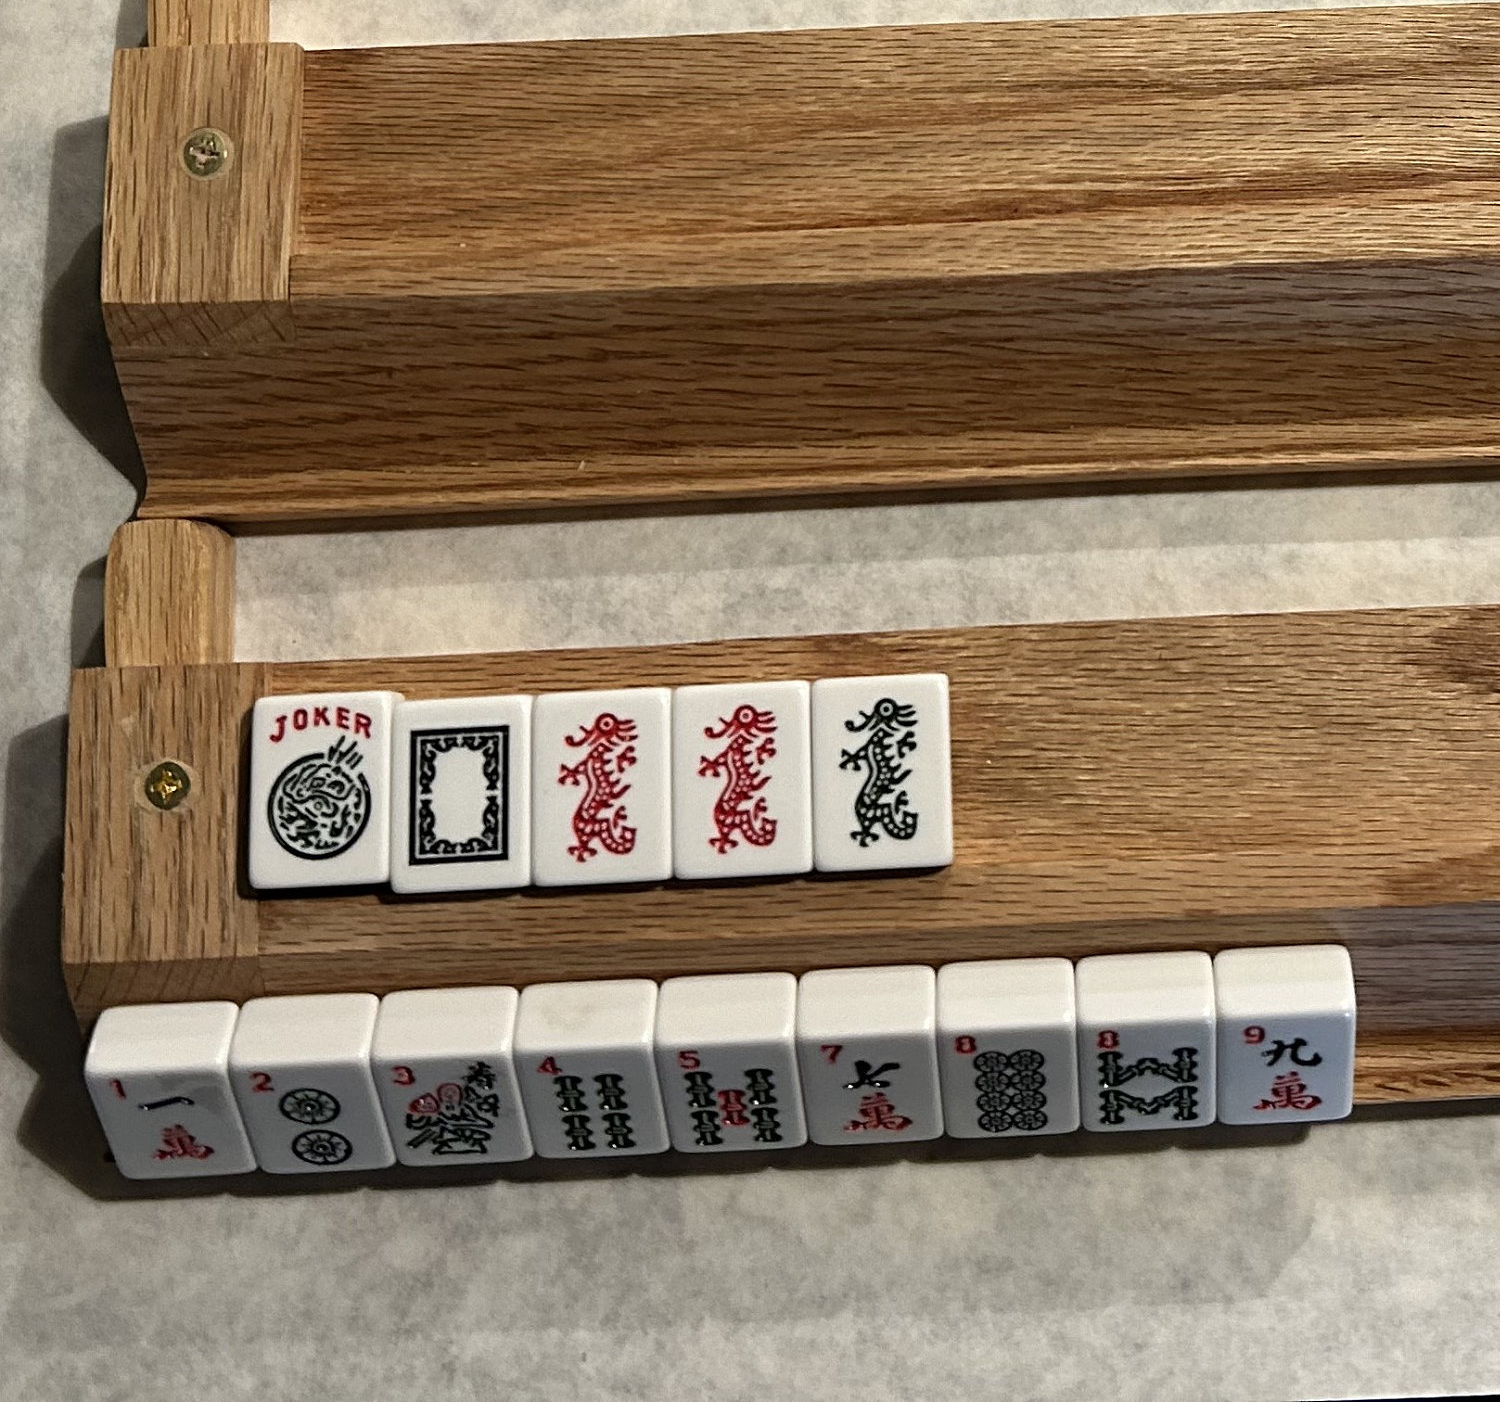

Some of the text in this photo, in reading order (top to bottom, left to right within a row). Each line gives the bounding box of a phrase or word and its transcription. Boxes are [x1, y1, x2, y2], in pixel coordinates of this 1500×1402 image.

[269, 705, 373, 744] JOKER
[955, 1035, 977, 1055] 8
[1097, 1029, 1120, 1050] 8
[1243, 1025, 1266, 1046] 9
[537, 1055, 563, 1075] 4
[678, 1050, 701, 1070] 5
[820, 1044, 843, 1065] 7
[249, 1072, 274, 1092] 2
[391, 1065, 416, 1086] 3
[109, 1078, 126, 1100] 1
